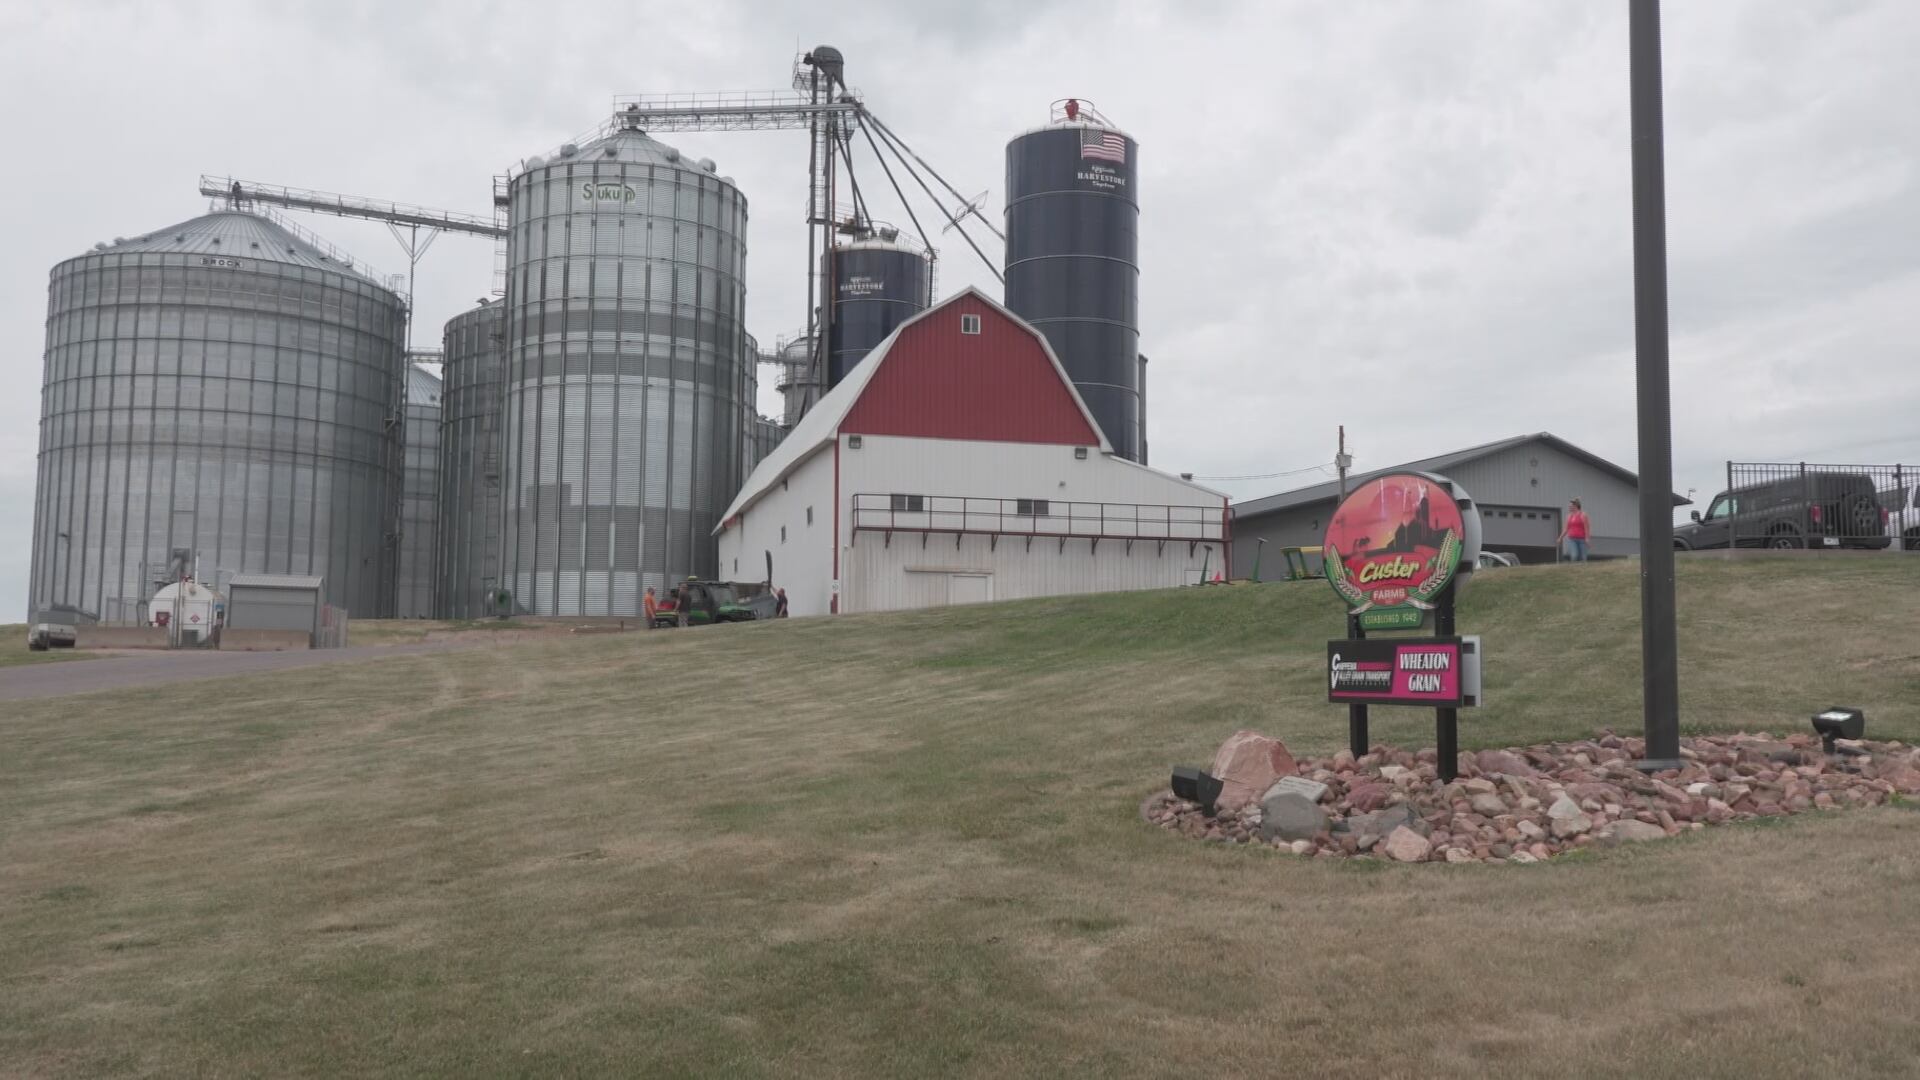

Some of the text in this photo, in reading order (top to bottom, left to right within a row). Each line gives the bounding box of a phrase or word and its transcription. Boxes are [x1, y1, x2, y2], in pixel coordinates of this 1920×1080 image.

[1360, 555, 1419, 583] Custer
[1373, 587, 1406, 600] FARMS
[1400, 652, 1449, 669] WHEATON
[1408, 673, 1440, 691] GRAIN
